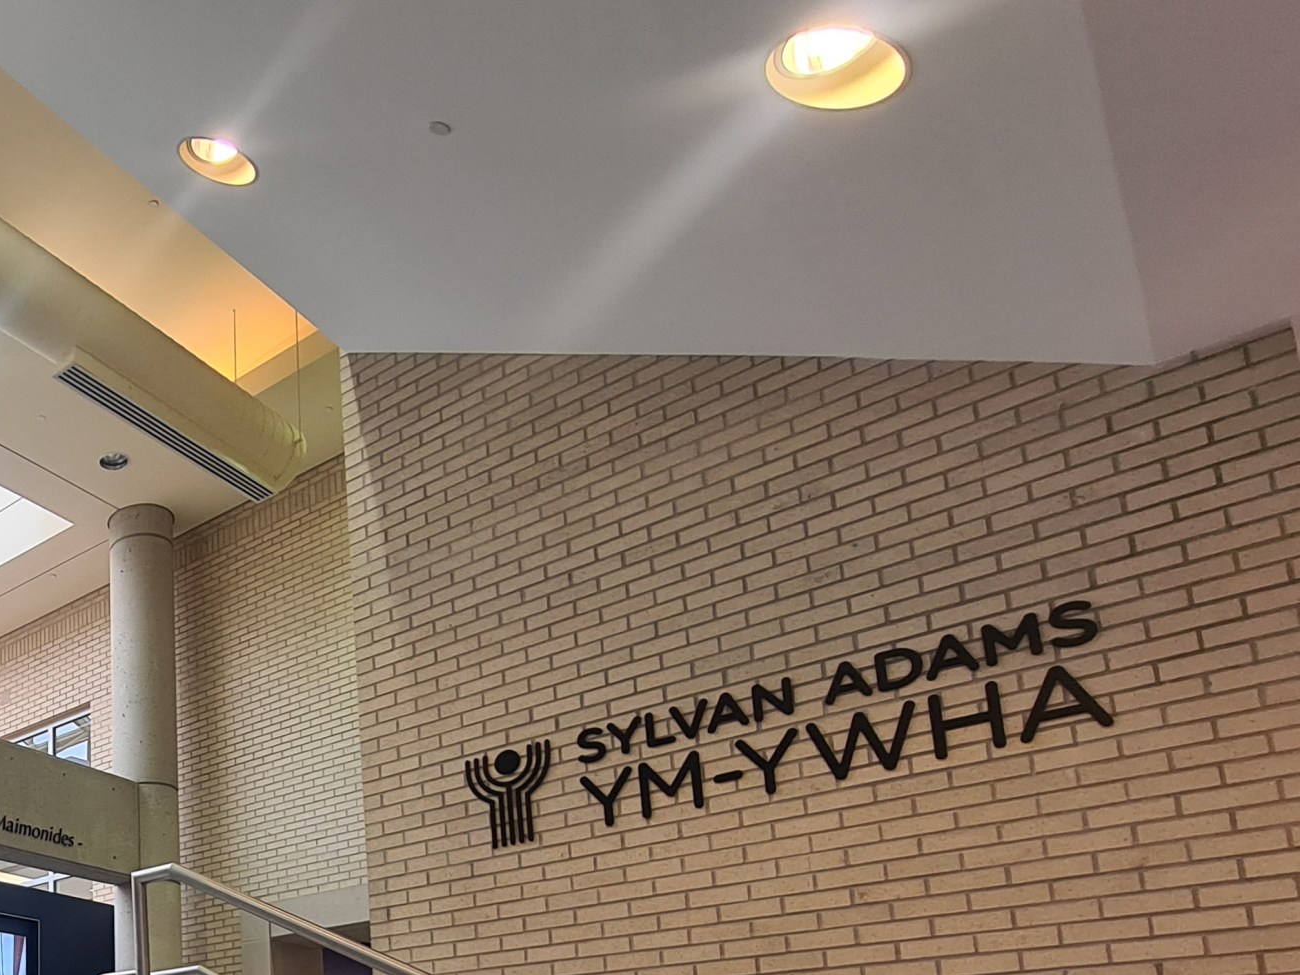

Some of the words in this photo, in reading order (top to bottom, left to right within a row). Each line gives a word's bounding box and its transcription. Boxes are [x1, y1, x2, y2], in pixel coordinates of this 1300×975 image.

[575, 676, 797, 764] SYLVAN
[823, 600, 1099, 706] ADAMS
[578, 665, 1114, 828] YM-YWHA
